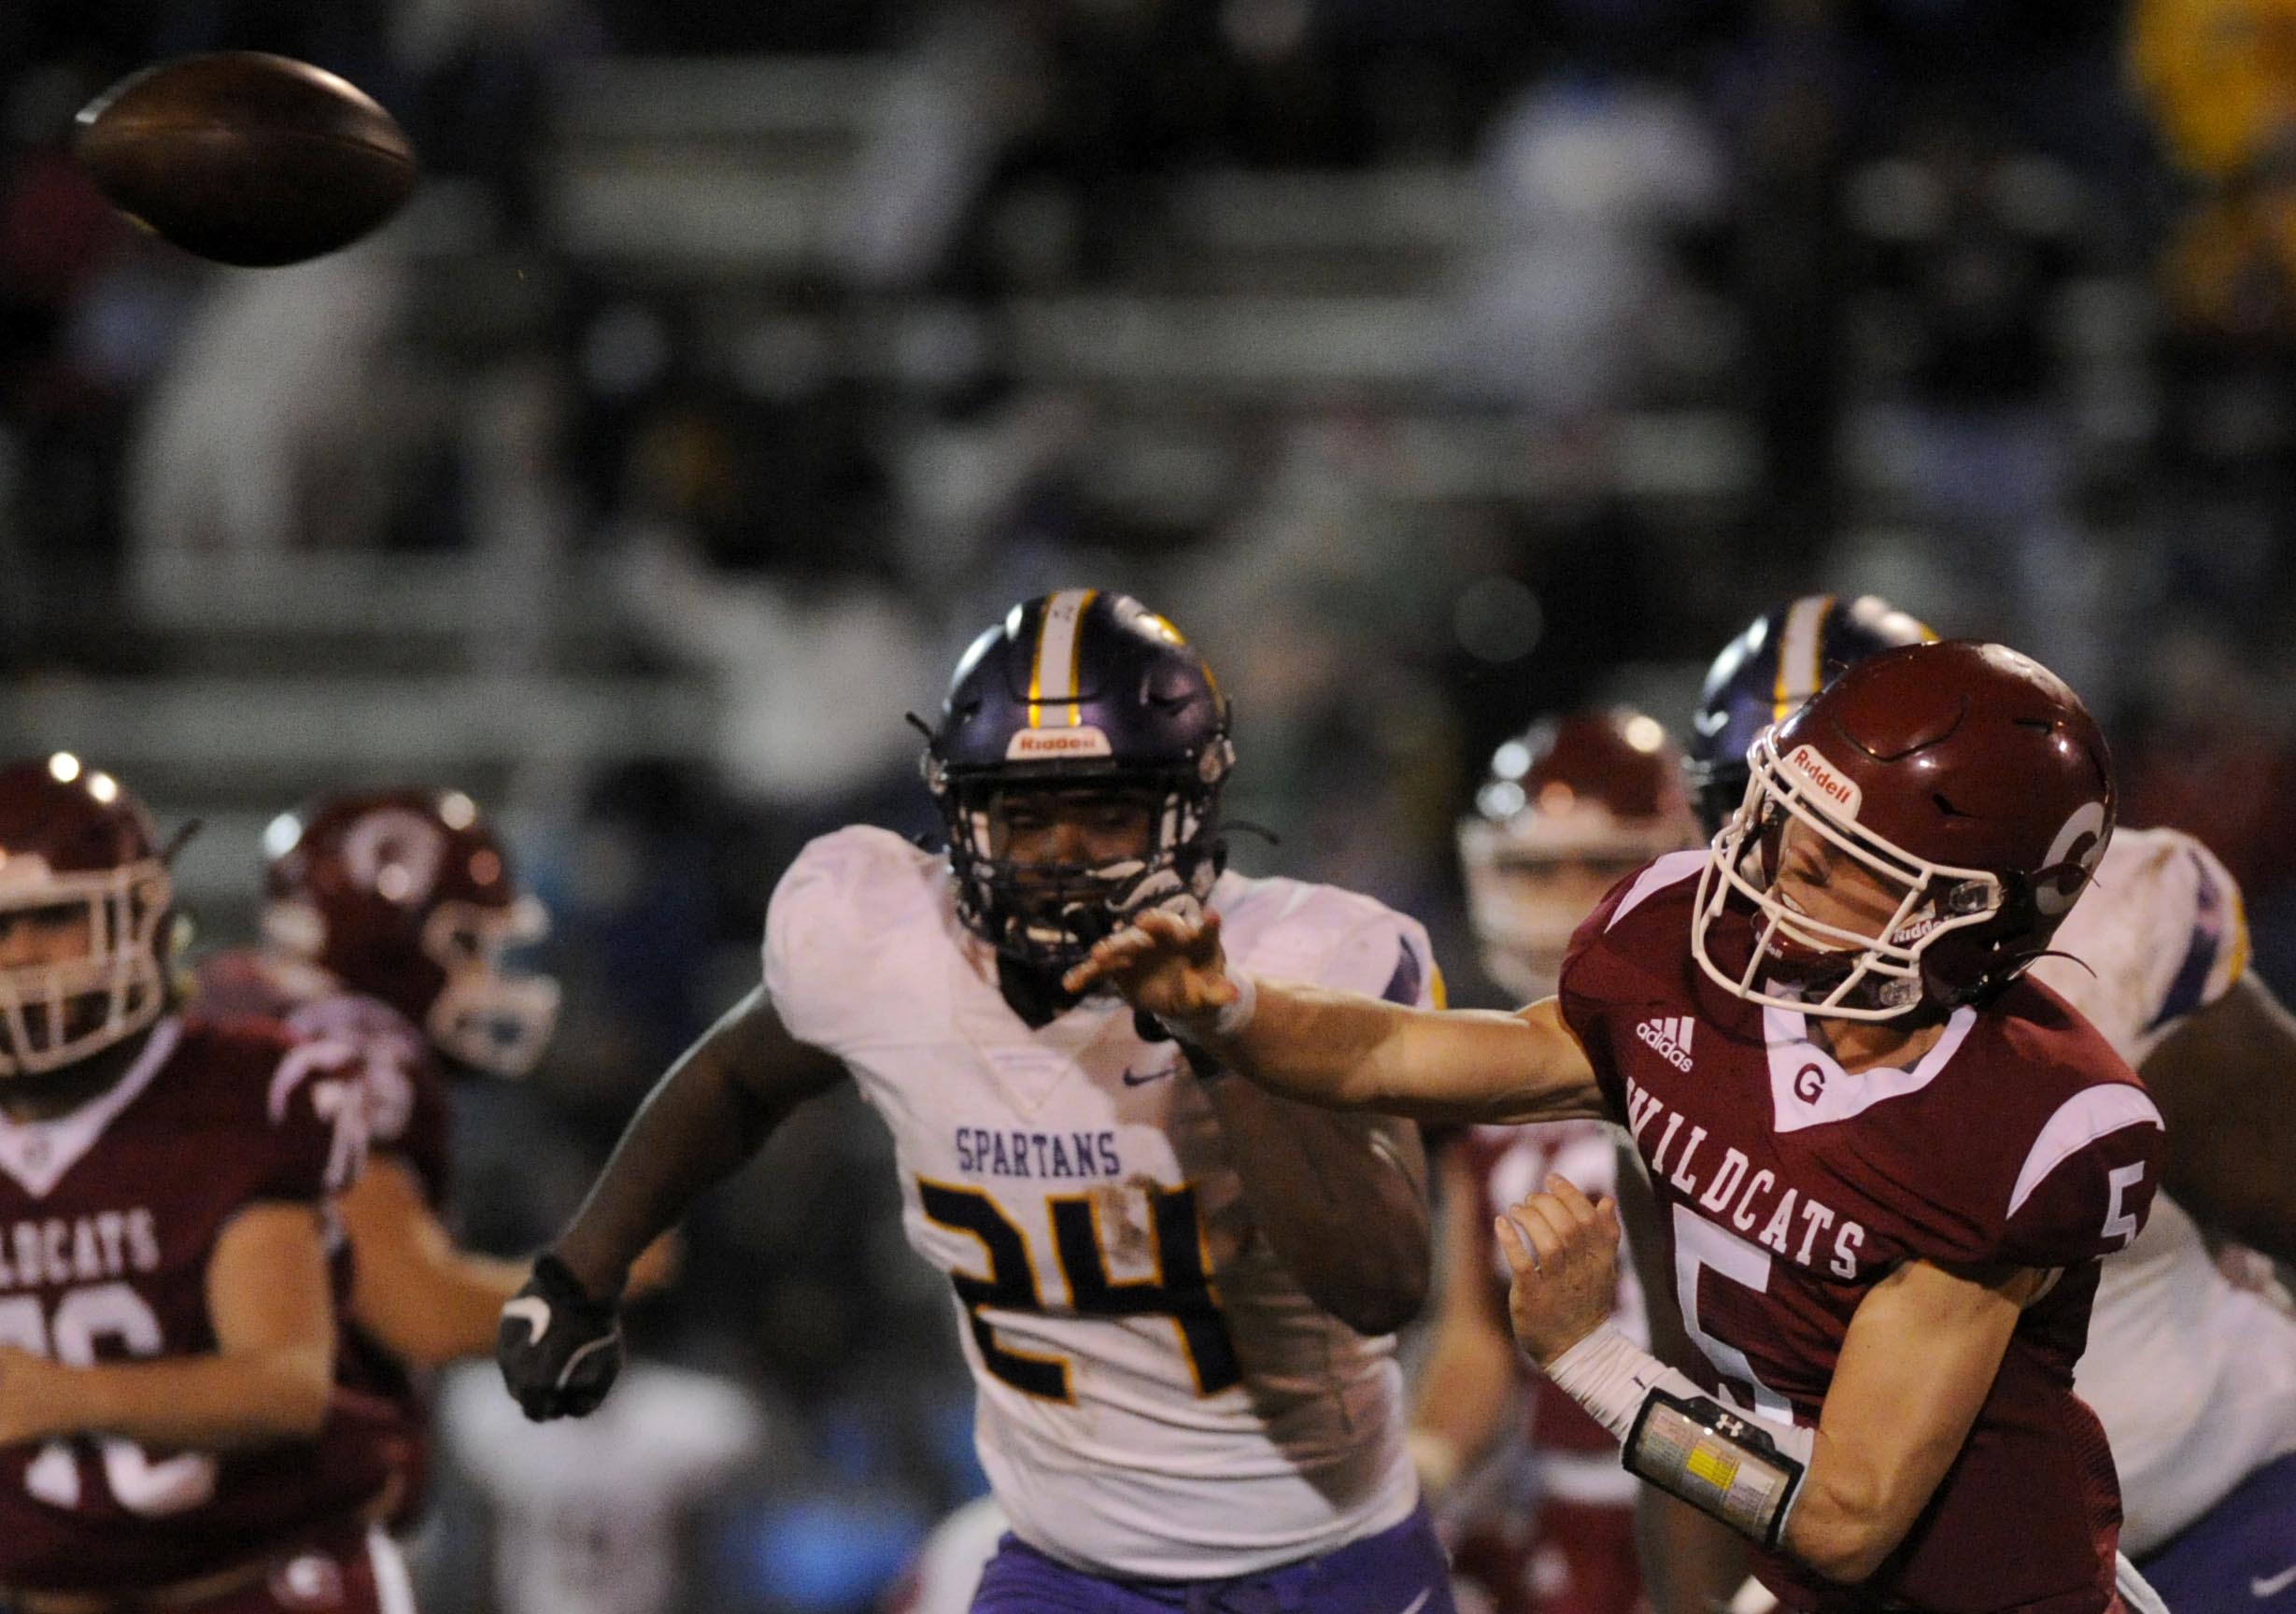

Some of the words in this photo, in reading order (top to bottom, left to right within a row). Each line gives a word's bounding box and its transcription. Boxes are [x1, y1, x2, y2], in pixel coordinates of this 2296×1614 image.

[1794, 748, 1852, 803] Riddell
[1637, 1022, 1694, 1072] adidas
[1793, 1062, 1825, 1106] G
[957, 1127, 1121, 1178] SPARTANS
[914, 1172, 1246, 1407] 24
[1673, 1202, 1795, 1425] 5
